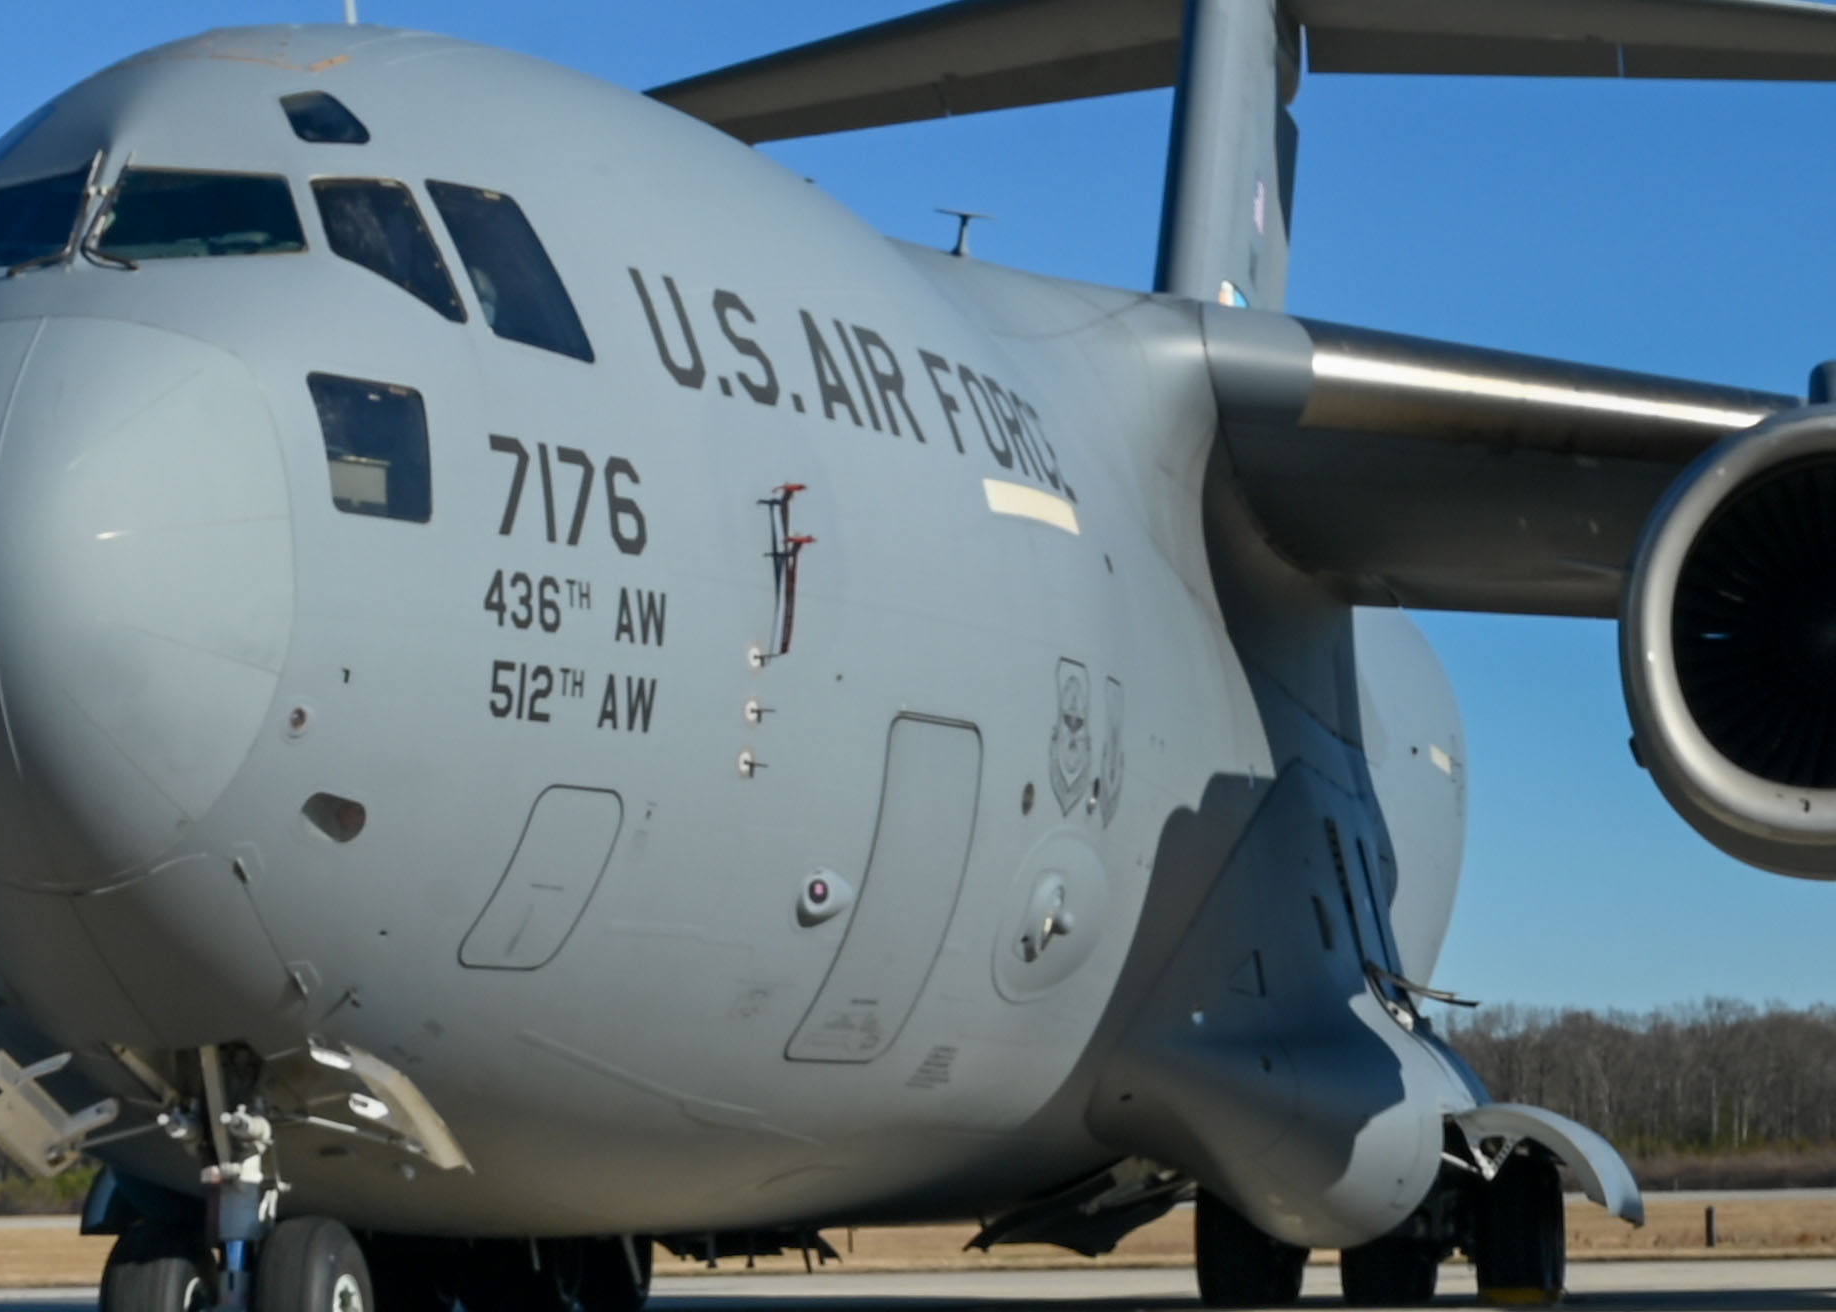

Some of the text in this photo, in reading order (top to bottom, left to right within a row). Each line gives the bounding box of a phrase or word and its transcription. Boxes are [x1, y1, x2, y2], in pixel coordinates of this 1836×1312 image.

[798, 309, 926, 444] AIR
[488, 434, 648, 555] 7176
[615, 587, 667, 647] AW
[597, 674, 656, 732] AW
